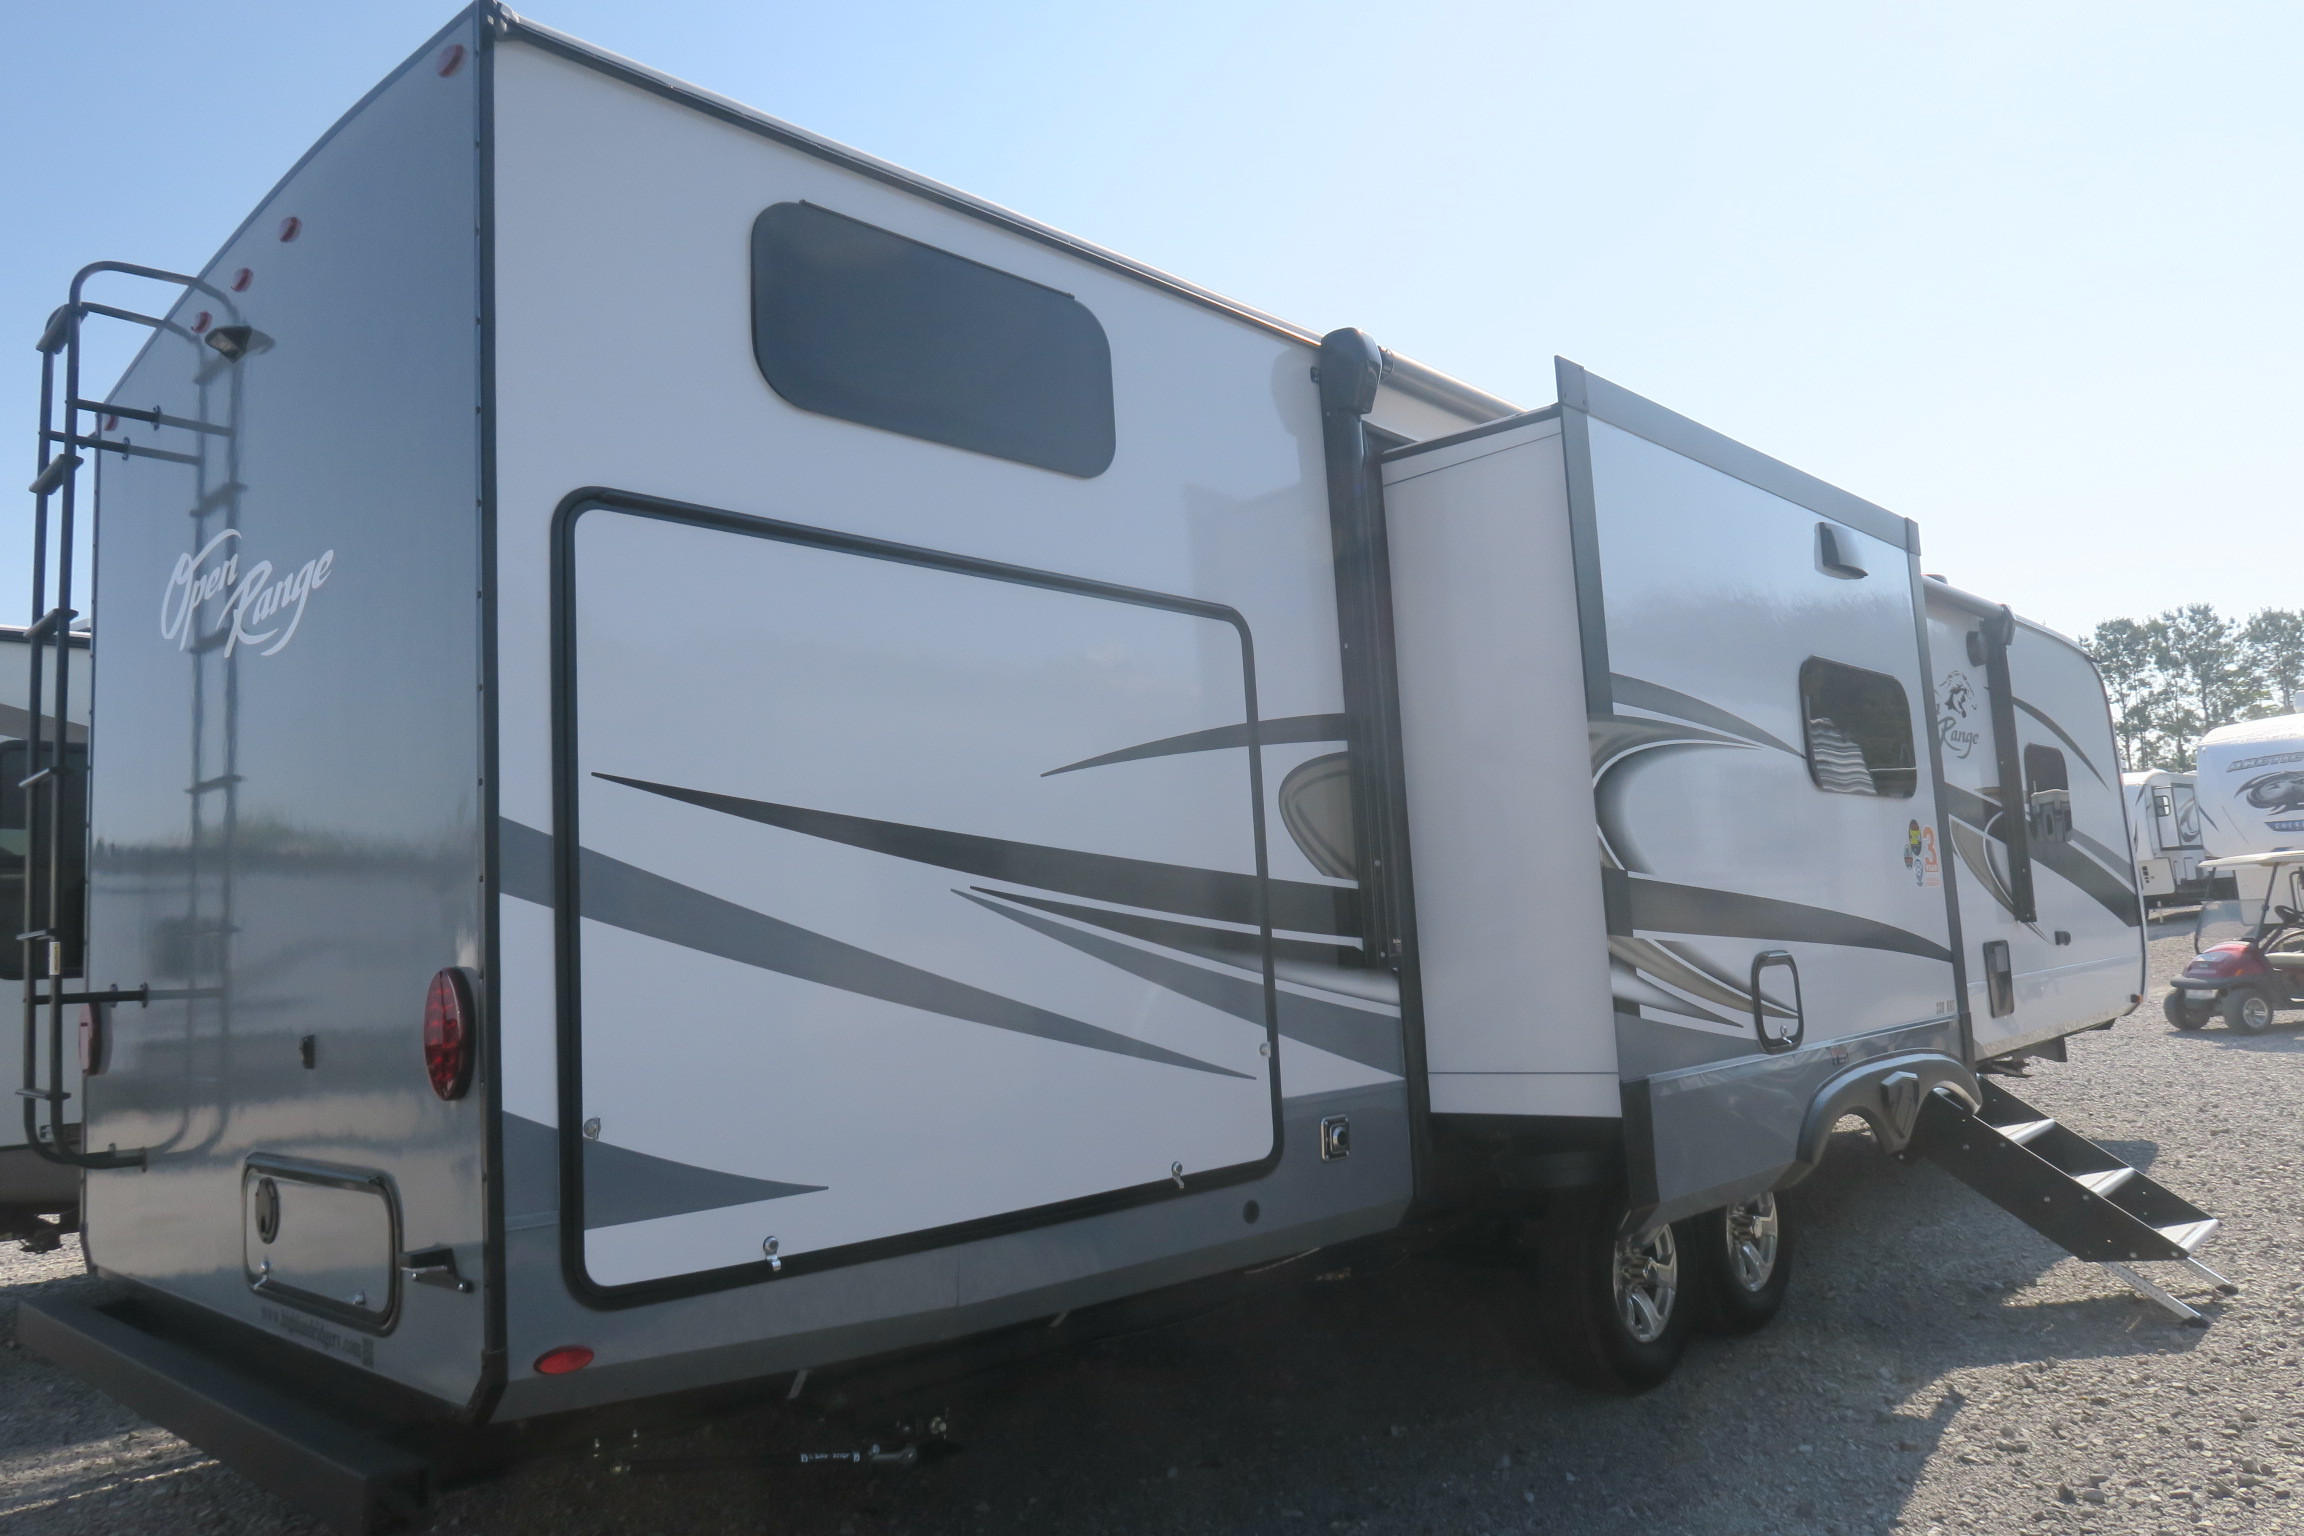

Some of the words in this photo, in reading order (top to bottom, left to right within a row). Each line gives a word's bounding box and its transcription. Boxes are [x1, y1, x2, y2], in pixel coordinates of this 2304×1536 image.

[161, 528, 242, 651] Open
[216, 550, 334, 658] Range
[1938, 716, 1979, 759] Range
[1923, 826, 1937, 865] 3
